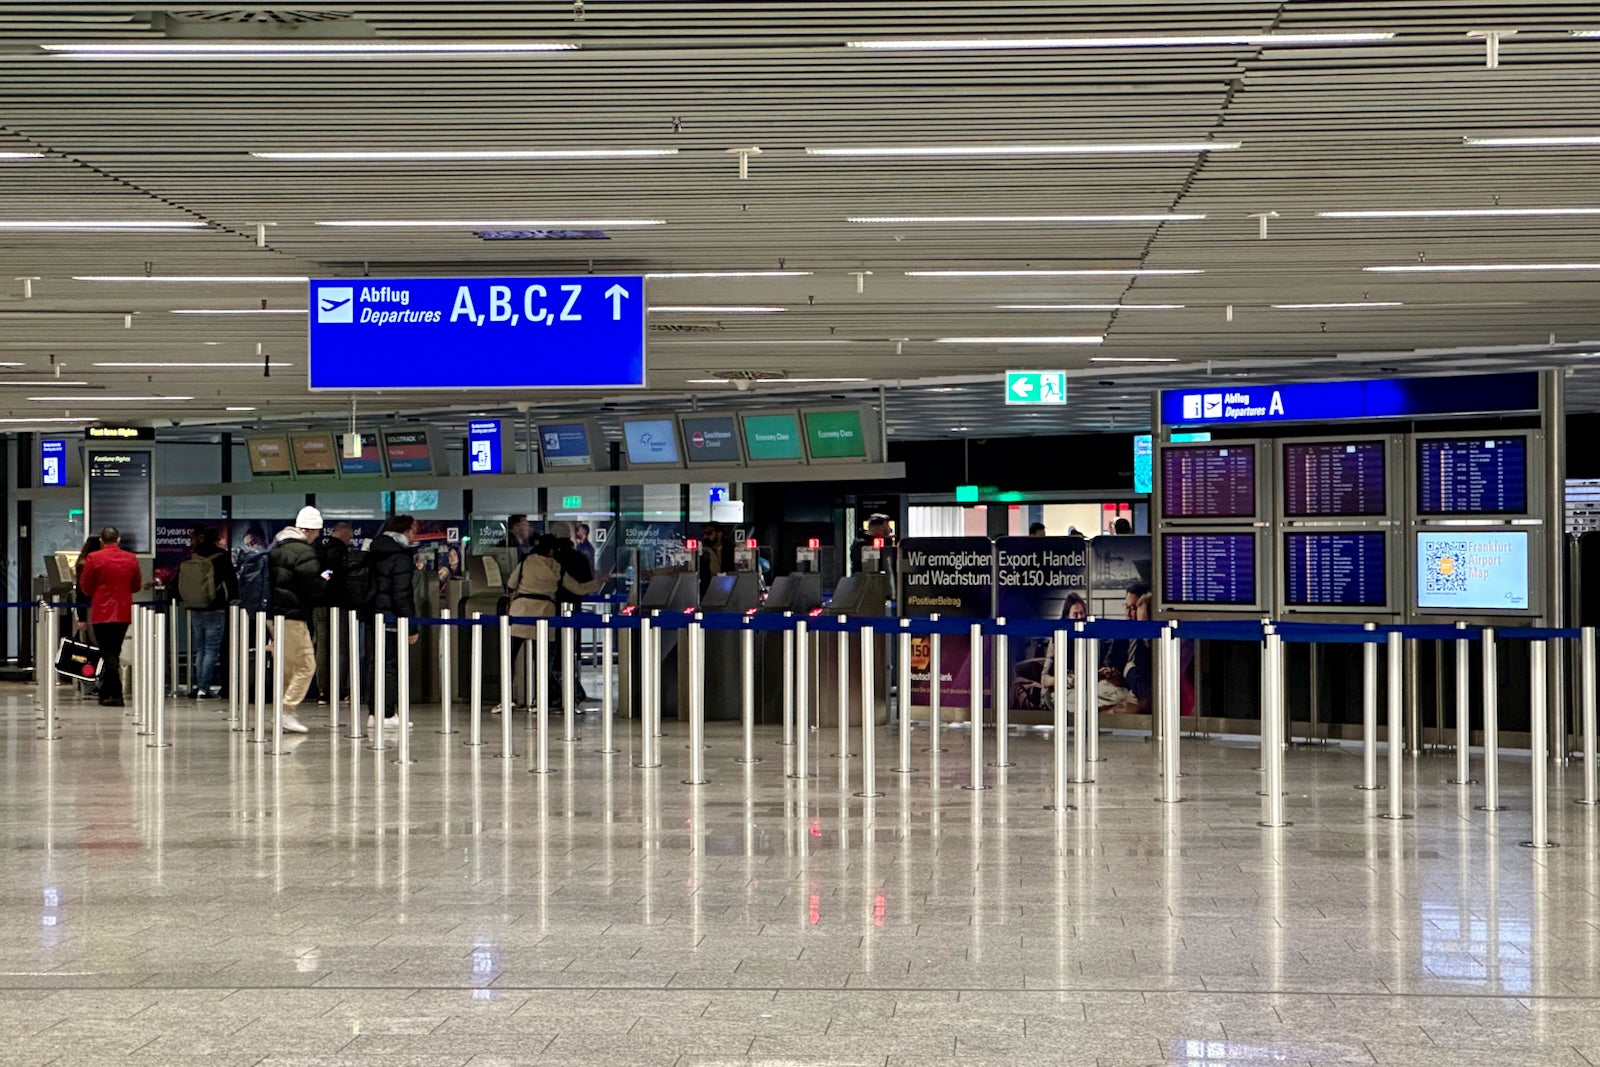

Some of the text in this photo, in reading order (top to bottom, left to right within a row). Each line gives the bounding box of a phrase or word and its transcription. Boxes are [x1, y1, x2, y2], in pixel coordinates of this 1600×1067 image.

[359, 287, 409, 305] Abflug
[360, 307, 441, 326] Departures
[1224, 391, 1284, 415] Abflug A
[1225, 406, 1266, 418] Departures
[755, 433, 776, 441] Economy
[818, 430, 839, 438] Economy
[167, 528, 186, 536] years
[156, 536, 191, 546] onnecting
[1468, 541, 1512, 553] Frankfurt
[908, 551, 993, 570] Wir ermöglichen
[999, 551, 1086, 569] Export, Handel
[1468, 554, 1502, 567] Airport
[908, 571, 993, 586] und Wachstum.
[998, 570, 1087, 586] Seit 150 Jahren.
[1468, 568, 1489, 578] Map
[911, 644, 929, 657] 150
